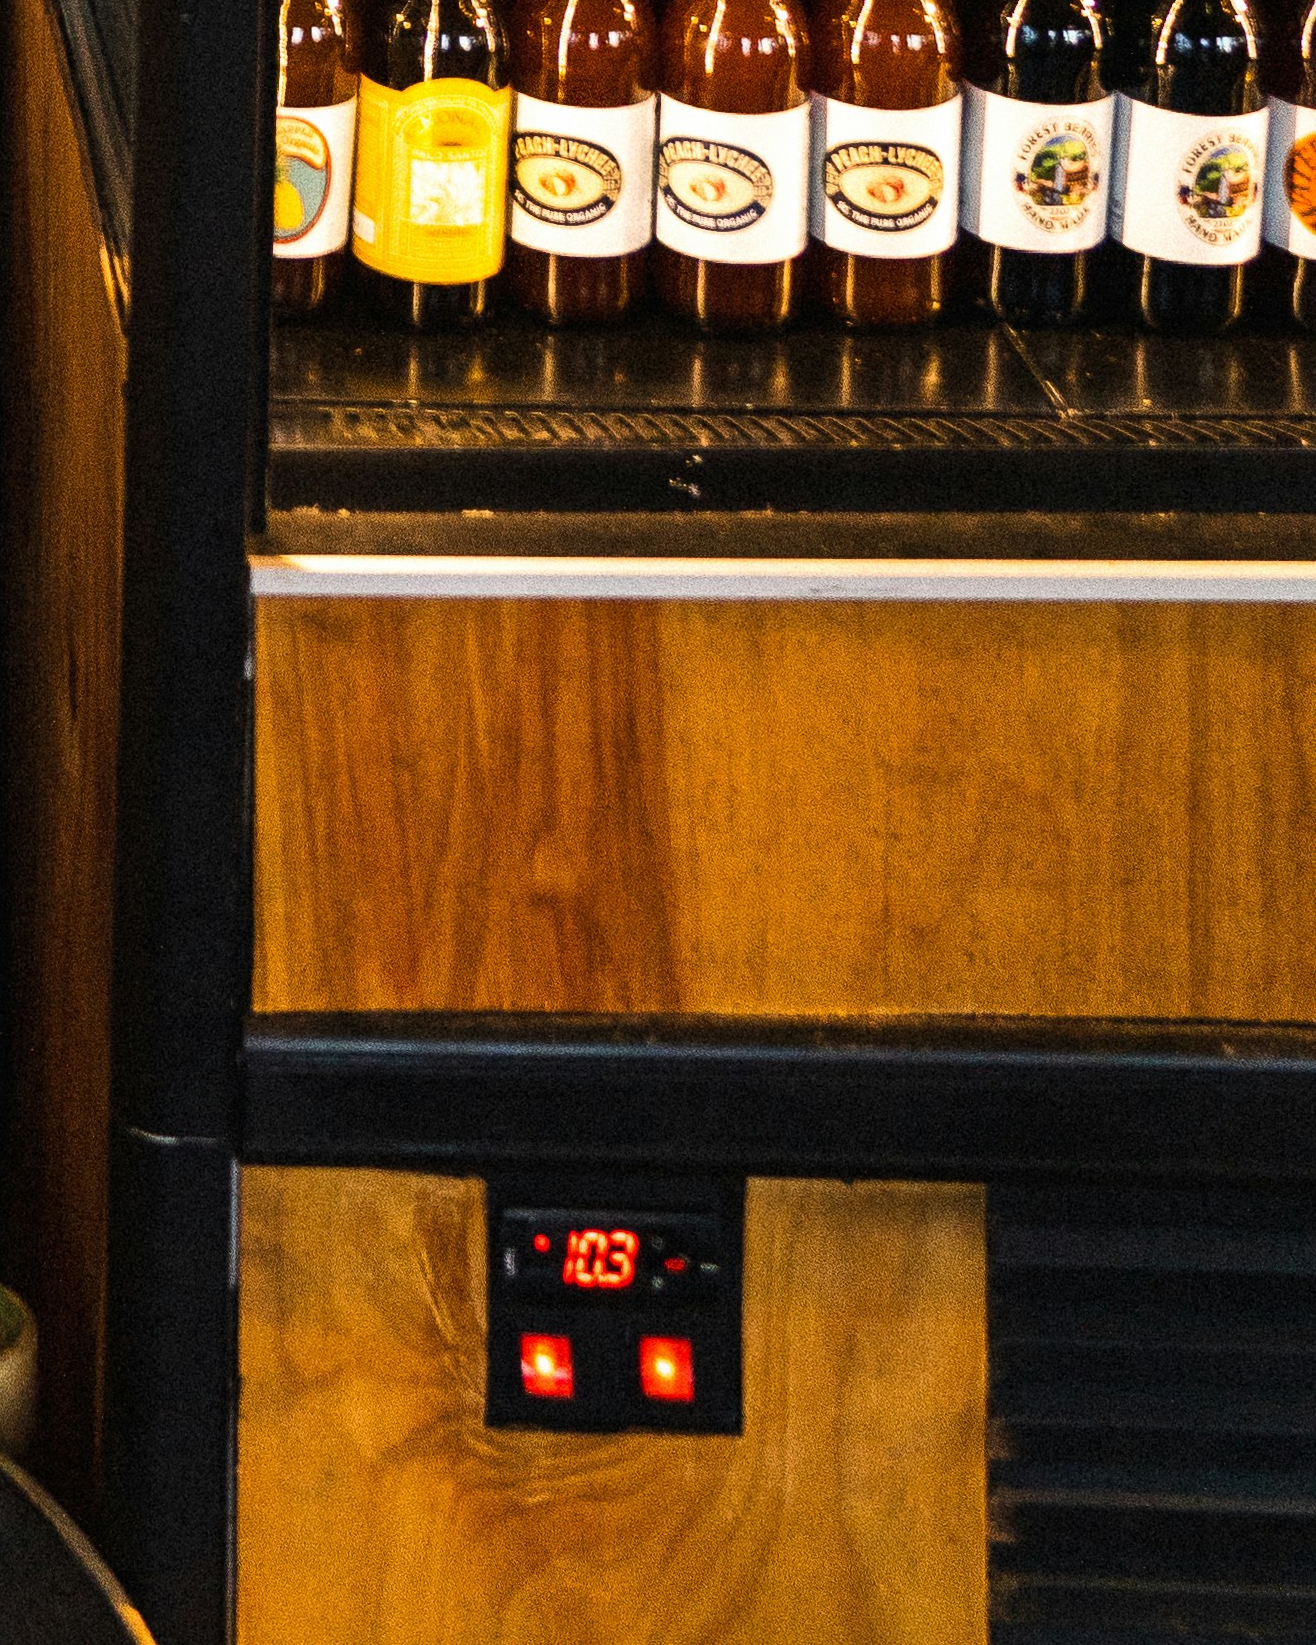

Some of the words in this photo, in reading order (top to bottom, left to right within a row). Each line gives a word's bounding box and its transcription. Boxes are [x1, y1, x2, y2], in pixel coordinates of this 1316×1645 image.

[1017, 122, 1058, 162] FOREST
[1182, 134, 1223, 175] FOREST
[565, 201, 607, 223] ORGANIC
[715, 208, 758, 231] ORGANIC
[895, 202, 934, 228] ORGANIC
[1022, 202, 1055, 230] HAND
[1185, 215, 1218, 243] HAND
